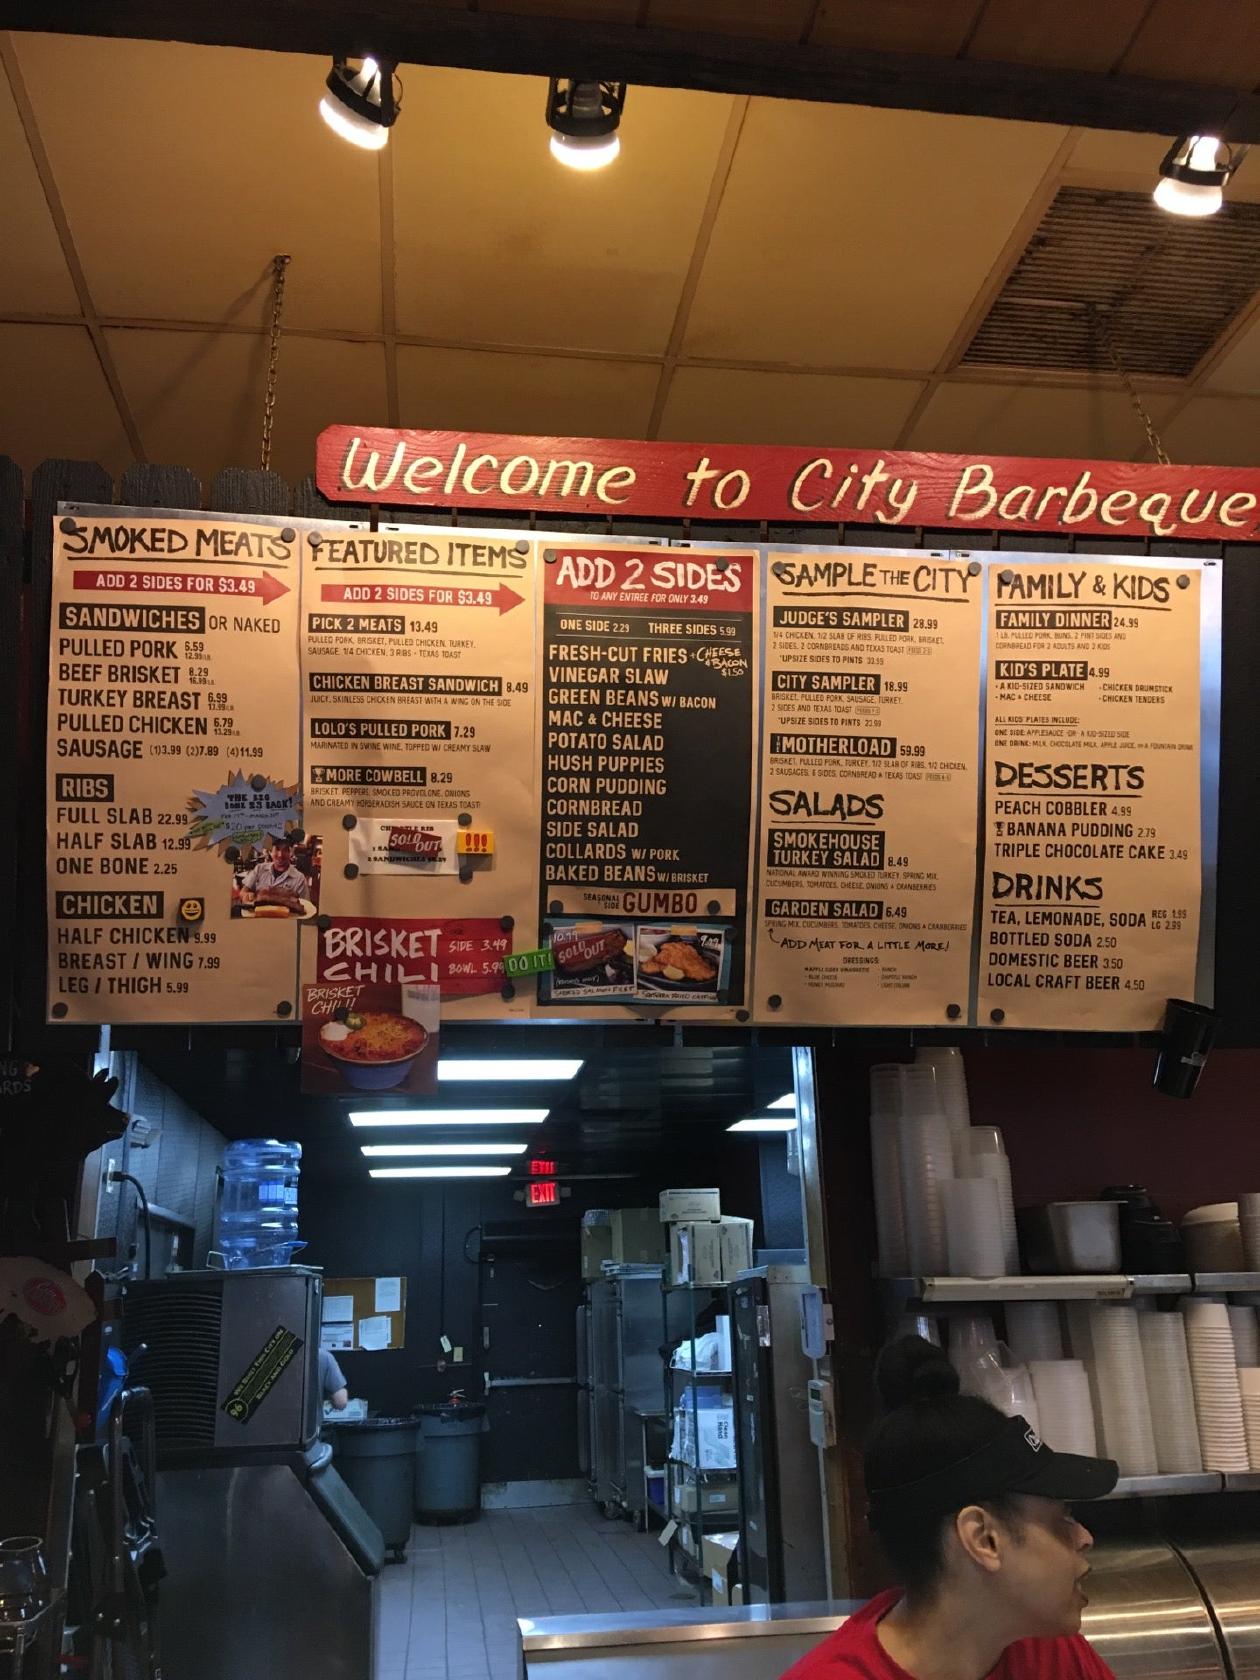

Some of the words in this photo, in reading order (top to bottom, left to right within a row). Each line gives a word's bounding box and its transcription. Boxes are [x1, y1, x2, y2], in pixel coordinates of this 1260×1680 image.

[342, 437, 636, 504] Welcome
[685, 458, 751, 510] to
[791, 458, 917, 524] City
[949, 464, 1257, 535] Barbeque
[62, 525, 188, 554] SMOKED
[195, 529, 292, 560] MEATS
[312, 539, 439, 565] FEATURED
[448, 542, 527, 569] ITEMS
[556, 556, 616, 588] ADD
[620, 559, 645, 589] 2
[651, 561, 741, 592] SIDES
[774, 562, 877, 587] SAMPLE
[880, 570, 910, 585] THE
[914, 566, 974, 592] CITY
[96, 574, 124, 588] ADD
[143, 575, 182, 590] SIDES
[187, 577, 214, 591] FOR
[219, 578, 256, 593] $3.49
[997, 572, 1087, 599] FAMILY
[1092, 575, 1106, 596] &
[1114, 573, 1171, 602] KIDS
[387, 588, 424, 601] SIDES
[458, 591, 492, 605] $3.49
[620, 593, 649, 602] ENTREE
[65, 607, 200, 629] SANDWICHES
[209, 616, 227, 630] OR
[234, 618, 280, 633] NAKED
[312, 618, 342, 630] PICK
[359, 618, 402, 631] MEATS
[561, 620, 582, 630] ONE
[585, 621, 610, 631] SIDE
[649, 623, 682, 634] THREE
[686, 624, 716, 635] SIDES
[780, 610, 837, 625] JUDGE'S
[843, 613, 904, 628] SAMPLER
[913, 619, 938, 629] 28.99
[1000, 613, 1050, 626] FAMILY
[1056, 613, 1109, 627] DINNER
[60, 639, 124, 657] PULLED
[130, 640, 178, 658] PORK
[549, 645, 638, 662] FRESH-CUT
[643, 648, 687, 664] FRIES
[697, 647, 741, 661] CHEESE
[711, 659, 747, 670] BACON
[1000, 663, 1036, 677] KID'S
[1042, 664, 1084, 677] PLATE
[59, 664, 102, 681] BEEF
[108, 666, 180, 684] BRISKET
[550, 667, 619, 683] VINEGAR
[625, 668, 668, 684] SLAW
[313, 676, 370, 690] CHICKEN
[375, 677, 423, 691] BREAST
[428, 679, 499, 692] SANDWICH
[778, 675, 806, 688] CITY
[812, 676, 875, 691] SAMPLER
[59, 689, 128, 707] TURKEY
[133, 691, 200, 710] BREAST
[549, 689, 600, 705] GREEN
[606, 690, 659, 706] BEANS
[680, 697, 716, 708] BACON
[58, 715, 124, 732] PULLED
[129, 716, 207, 735] CHICKEN
[549, 711, 582, 726] MAC
[602, 712, 662, 728] CHEESE
[315, 723, 356, 735] LOLO'S
[361, 723, 407, 737] PULLED
[412, 725, 446, 737] PORK
[57, 740, 142, 758] SAUSAGE
[548, 732, 606, 749] POTATO
[612, 735, 664, 750] SALAD
[782, 736, 891, 755] MOTHERLOAD
[548, 755, 592, 771] HUSH
[598, 756, 664, 773] PUPPIES
[326, 769, 361, 781] MORE
[366, 770, 423, 783] COWBELL
[995, 761, 1144, 790] DESSERTS
[62, 779, 108, 798] RIBS
[547, 777, 590, 793] CORN
[597, 778, 666, 794] PUDDING
[547, 800, 642, 815] CORNBREAD
[769, 790, 884, 821] SALADS
[995, 801, 1040, 815] PEACH
[1046, 802, 1107, 815] COBBLER
[57, 808, 100, 824] FULL
[107, 808, 152, 824] SLAB
[547, 822, 582, 837] SIDE
[588, 822, 639, 837] SALAD
[1007, 823, 1066, 837] BANANA
[1072, 823, 1132, 837] PUDDING
[57, 833, 103, 849] HALF
[111, 834, 156, 850] SLAB
[390, 834, 421, 846] SOLD
[416, 841, 441, 852] OUT
[774, 832, 879, 850] SMOKEHOUSE
[546, 843, 626, 859] COLLARDS
[650, 849, 679, 860] PORK
[774, 851, 828, 865] TURKEY
[833, 852, 879, 866] SALAD
[995, 844, 1040, 857] TRIPLE
[1045, 844, 1124, 858] CHOCOLATE
[1129, 845, 1165, 859] CAKE
[56, 858, 93, 874] ONE
[100, 859, 148, 874] BONE
[546, 865, 598, 881] BAKED
[604, 866, 656, 881] BEANS
[672, 873, 708, 882] BRISKET
[993, 872, 1103, 900] DRINKS
[63, 896, 157, 915] CHICKEN
[623, 892, 697, 913] GUMBO
[771, 902, 828, 916] GARDEN
[833, 903, 878, 917] SALAD
[991, 912, 1021, 925] TEA,
[1025, 912, 1105, 927] LEMONADE,
[1110, 913, 1146, 927] SODA
[58, 928, 102, 944] HALF
[109, 928, 189, 945] CHICKEN
[323, 928, 442, 958] BRISKET
[780, 938, 806, 949] ADD
[809, 938, 835, 951] MEAT
[840, 941, 864, 950] FOR
[878, 941, 910, 949] LITTLE
[990, 933, 1049, 946] BOTTLED
[1054, 934, 1092, 947] SODA
[449, 940, 473, 953] SIDE
[559, 941, 585, 963] SOLD
[584, 940, 605, 959] OUT
[59, 953, 126, 969] BREAST
[146, 953, 193, 969] WING
[508, 957, 528, 971] DO
[533, 954, 553, 966] IT!
[989, 953, 1059, 967] DOMESTIC
[1064, 954, 1098, 968] BEER
[323, 963, 439, 984] CHILI
[988, 973, 1030, 987] LOCAL
[1036, 975, 1081, 989] CRAFT
[1086, 977, 1120, 990] BEER
[59, 978, 88, 993] LEG
[109, 978, 161, 993] THIGH
[308, 985, 364, 1000] BRISKET
[530, 1183, 555, 1203] EXIT
